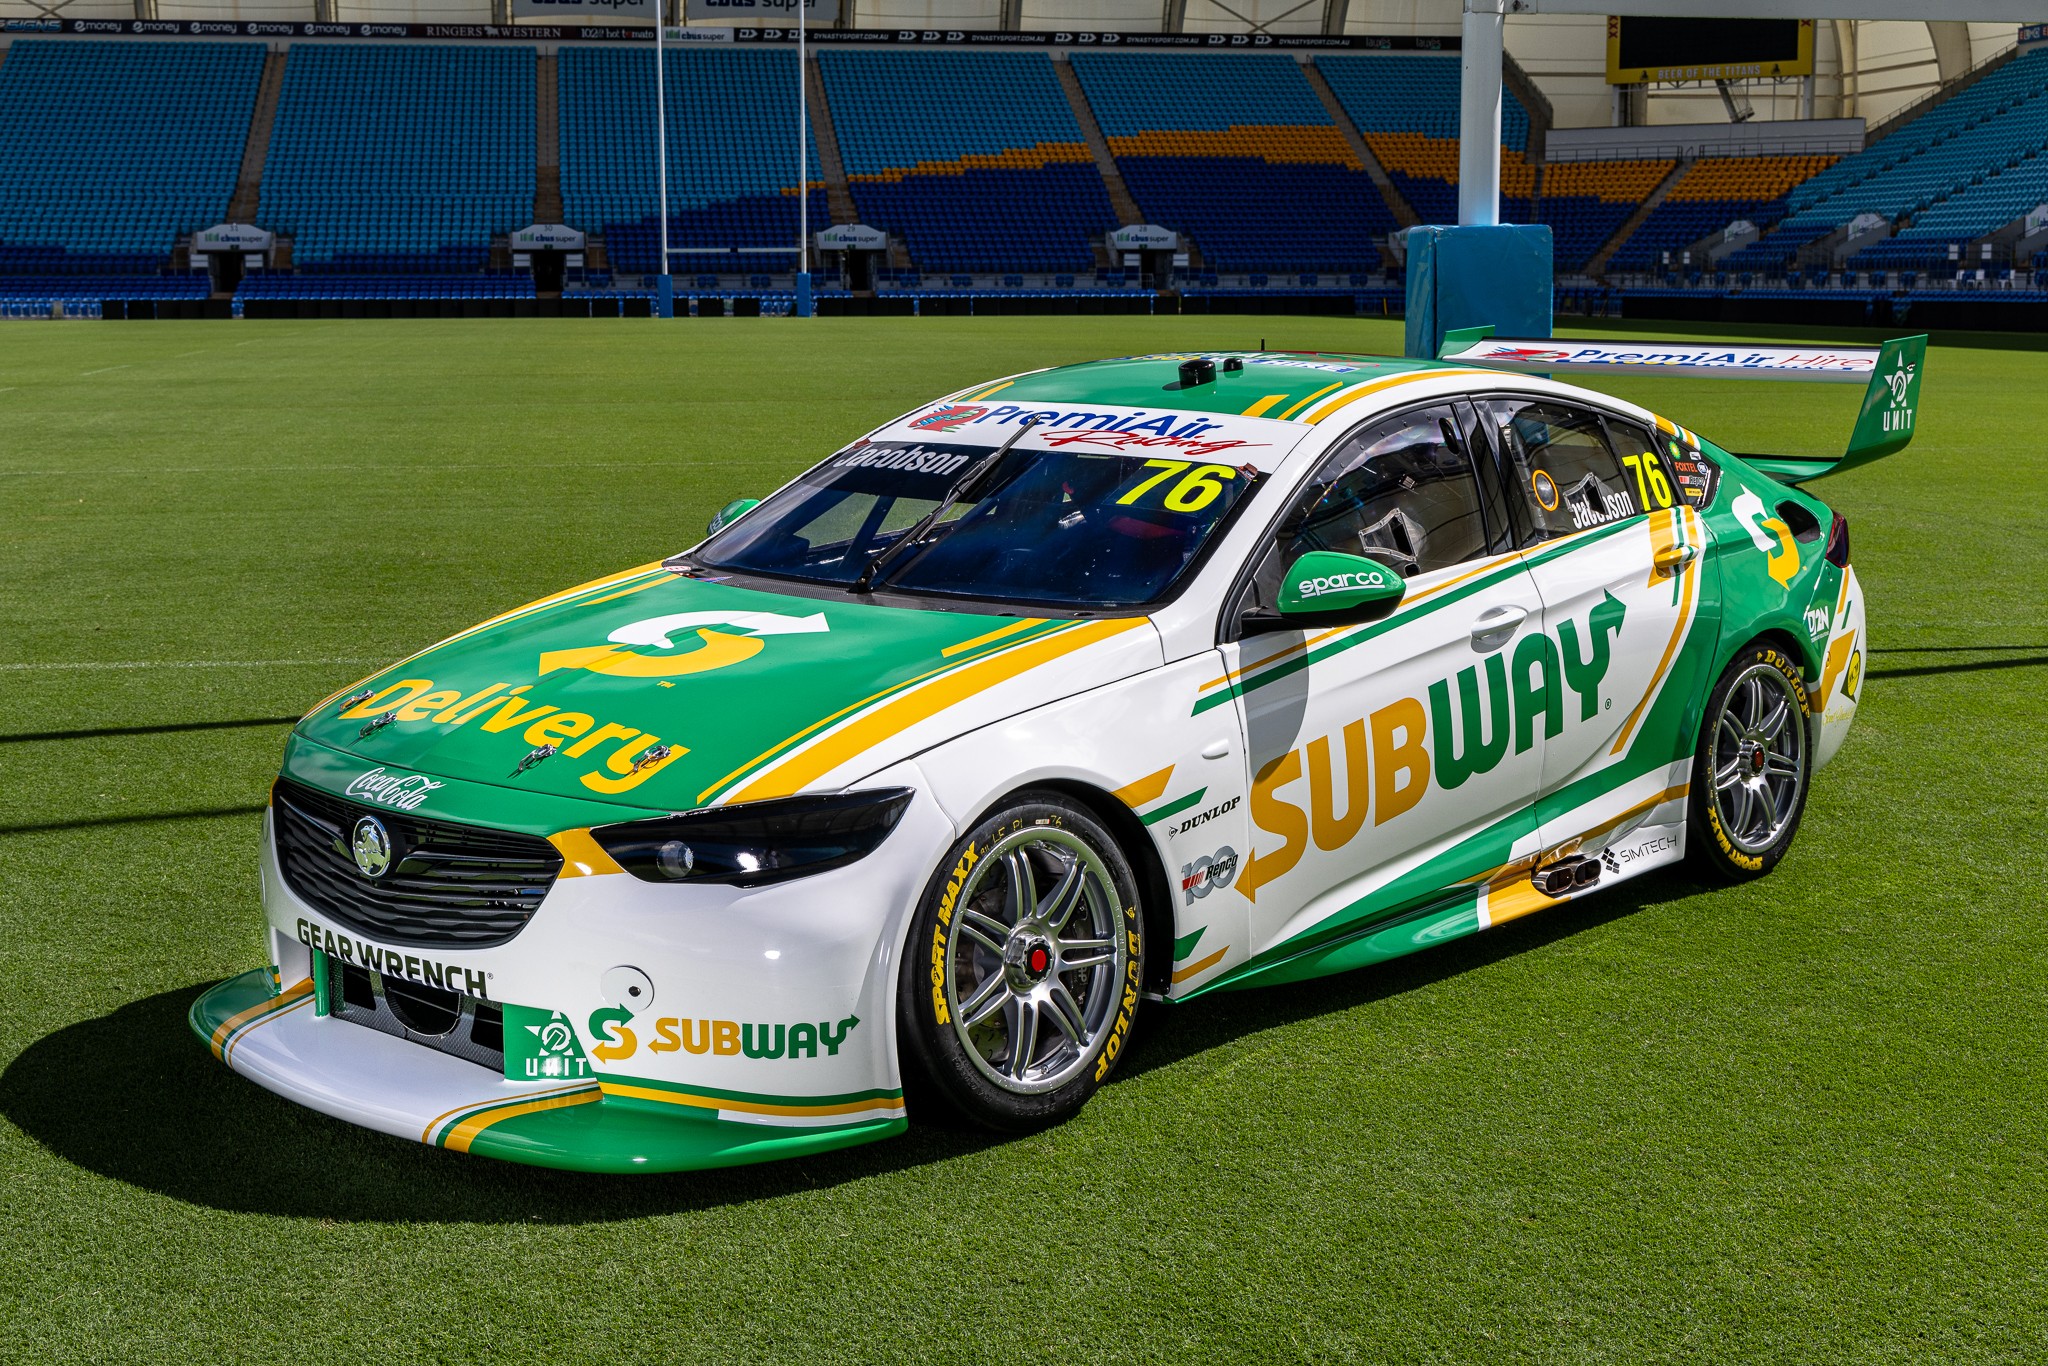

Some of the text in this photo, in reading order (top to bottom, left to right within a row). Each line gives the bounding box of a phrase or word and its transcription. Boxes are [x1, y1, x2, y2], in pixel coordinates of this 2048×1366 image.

[425, 25, 562, 38] RINGERS WESTERN
[681, 29, 725, 42] cbus super
[1658, 65, 1761, 80] BEER OF THE TITANS
[1571, 349, 1875, 369] PremiAir Hire
[981, 405, 1224, 440] PremiAir
[833, 444, 969, 476] Jacobson
[1040, 429, 1273, 456] Racing
[1622, 452, 1673, 512] 76
[1674, 461, 1698, 473] FOXTEL
[1116, 459, 1237, 512] 76
[1299, 572, 1384, 597] sparco
[339, 679, 692, 794] Delivery
[1234, 588, 1626, 904] SUBWAY
[345, 767, 447, 811] Coca-Cola
[1180, 795, 1241, 834] DUNLOP
[1619, 834, 1678, 864] SIMTECH
[1204, 854, 1240, 882] Repco
[297, 918, 354, 963] GEAR
[930, 841, 979, 1025] SPORT MAXX
[1095, 930, 1141, 1082] DUNLOP
[648, 1014, 861, 1060] SUBWAY
